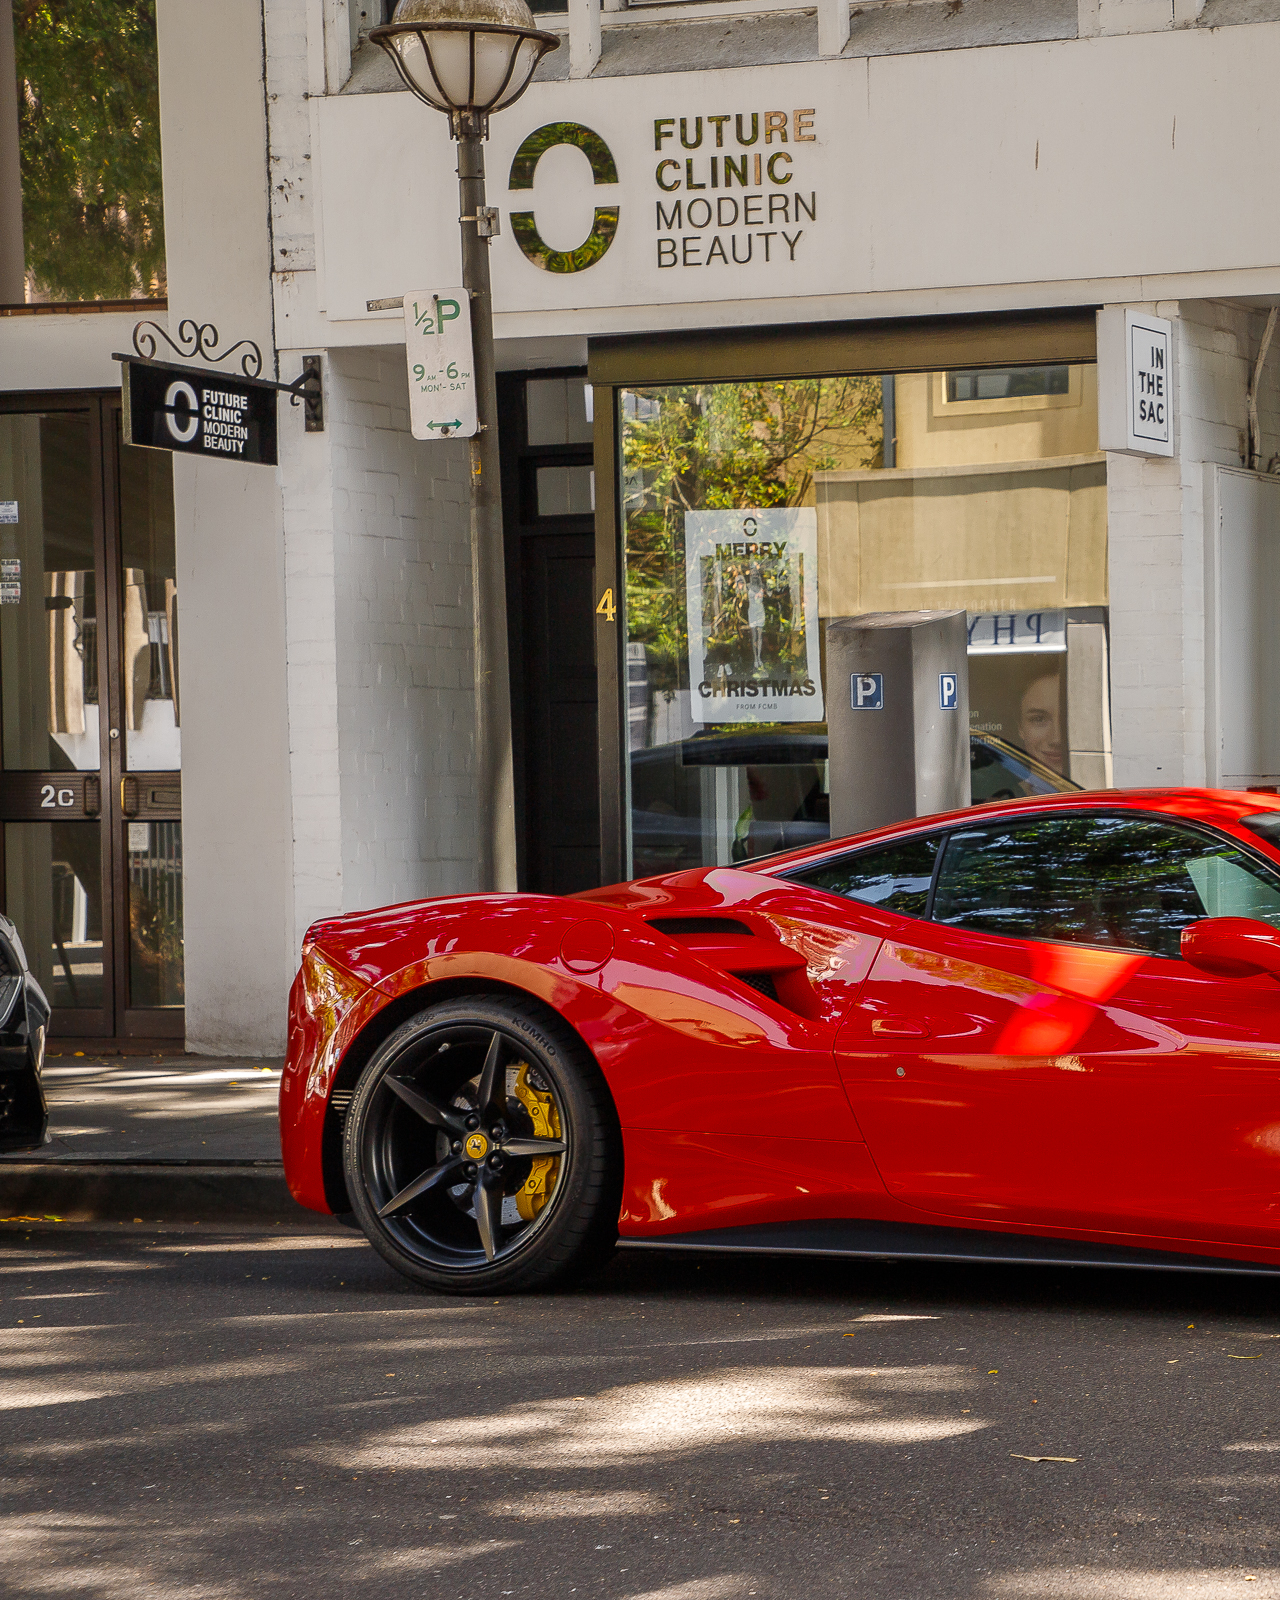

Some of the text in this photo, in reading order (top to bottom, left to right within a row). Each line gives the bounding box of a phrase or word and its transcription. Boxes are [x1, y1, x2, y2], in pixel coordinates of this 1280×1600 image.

[653, 108, 816, 151] FUTURE
[655, 151, 793, 192] CLINIC
[656, 191, 816, 231] MODERN
[657, 230, 803, 268] BEAUTY
[1150, 346, 1164, 370] IN
[421, 384, 440, 393] MON
[449, 383, 466, 391] SAT
[1138, 371, 1164, 396] THE
[202, 389, 248, 410] FUTURE
[1139, 399, 1164, 424] SAC
[203, 405, 242, 424] CLINIC
[203, 421, 248, 440] MODERN
[204, 435, 244, 453] BEAUTY
[715, 541, 788, 560] MERRY
[596, 588, 617, 622] 4
[698, 678, 816, 698] CHRISTMAS
[856, 677, 877, 706] P
[942, 676, 955, 706] P
[512, 1016, 556, 1056] KUMHO
